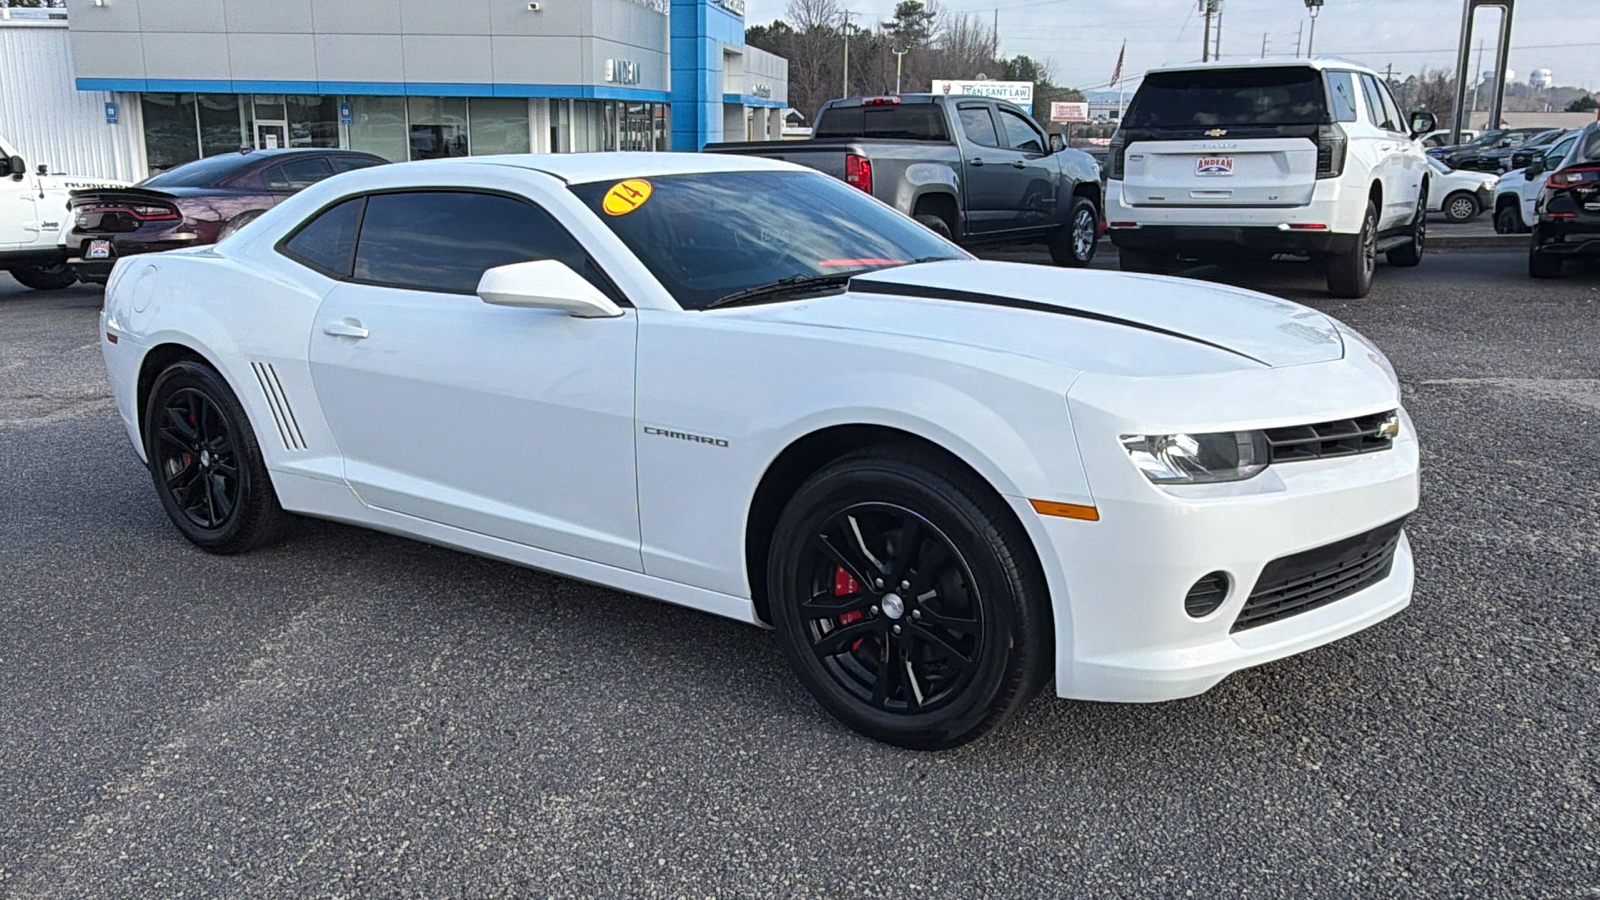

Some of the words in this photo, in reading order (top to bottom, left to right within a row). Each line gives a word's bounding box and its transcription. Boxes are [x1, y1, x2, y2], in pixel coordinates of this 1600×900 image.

[985, 88, 1007, 96] SANT
[1009, 89, 1027, 97] LAW
[1197, 159, 1233, 170] ANDEAN
[612, 183, 643, 207] 14
[643, 426, 729, 448] CAMARO
